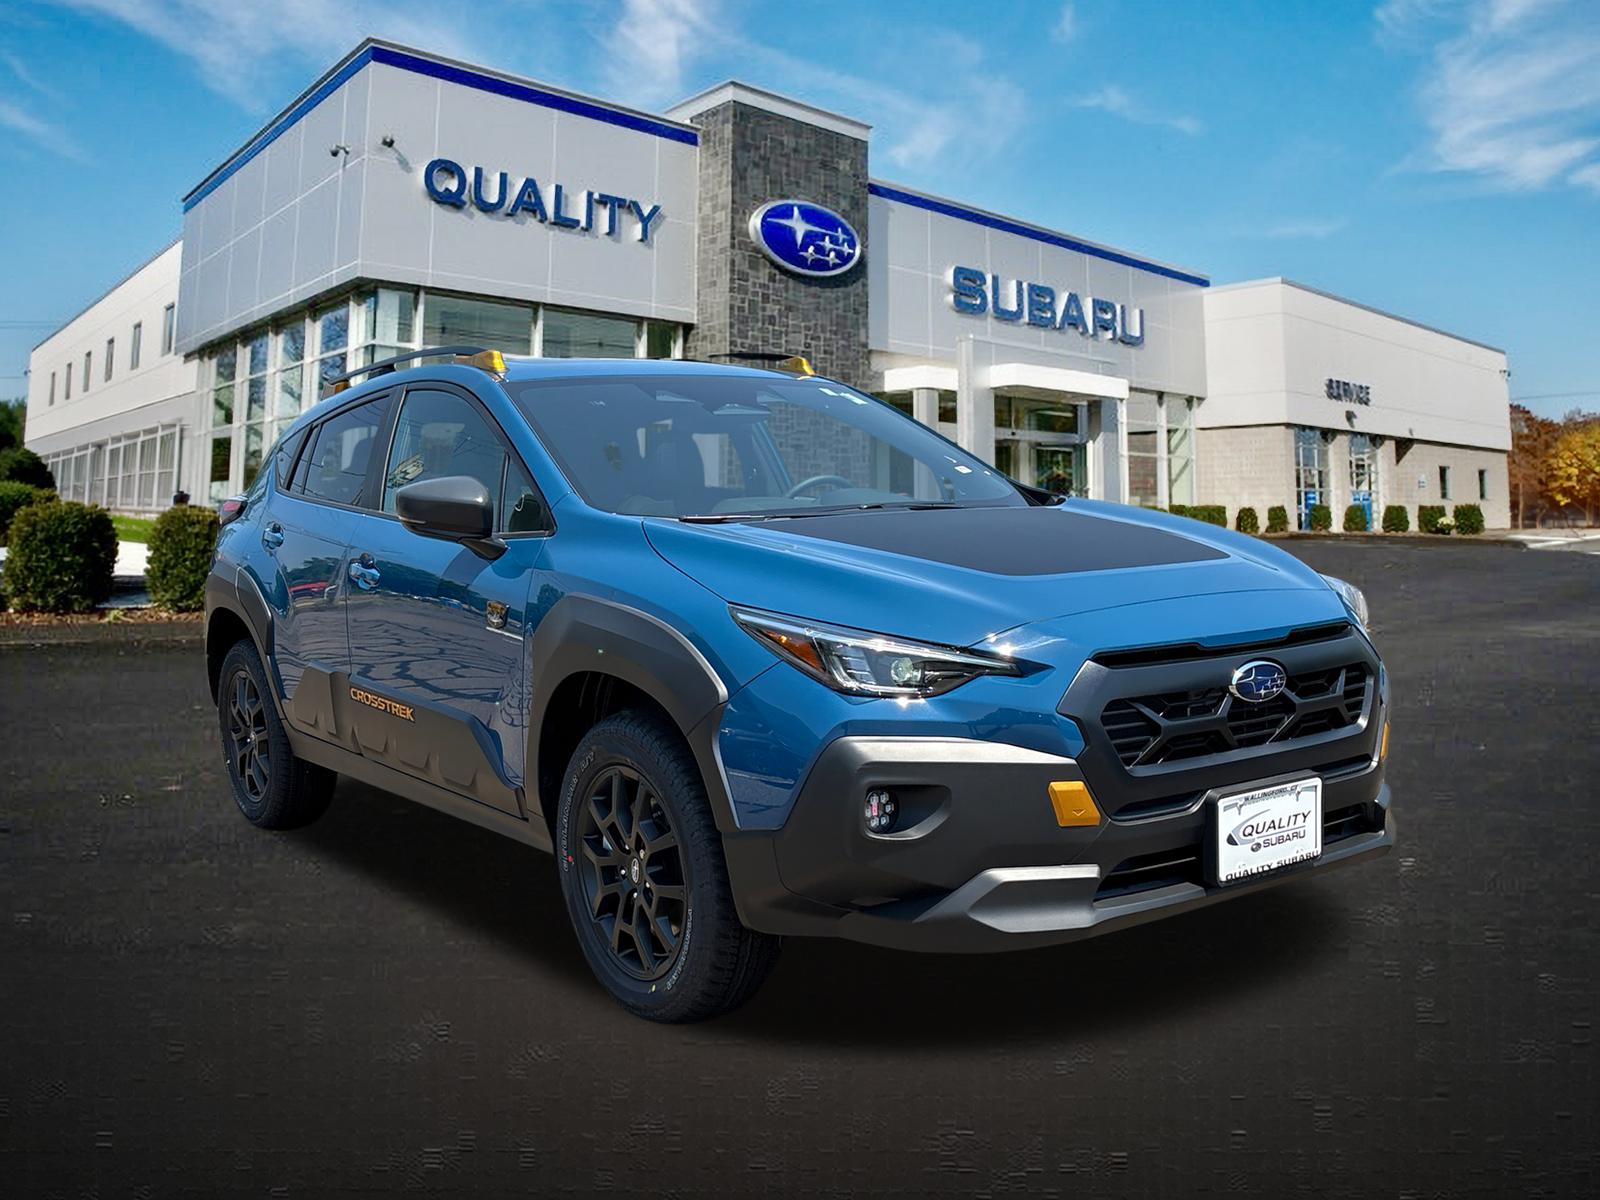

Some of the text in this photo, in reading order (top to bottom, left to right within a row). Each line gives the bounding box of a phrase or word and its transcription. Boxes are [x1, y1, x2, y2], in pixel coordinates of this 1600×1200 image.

[423, 158, 662, 242] QUALITY
[949, 265, 1145, 347] SUBARU
[350, 687, 415, 722] CROSSTREK
[1242, 810, 1312, 838] QUALITY
[1262, 829, 1306, 849] SUBARU
[1225, 850, 1320, 881] QUALITY SUBARU
